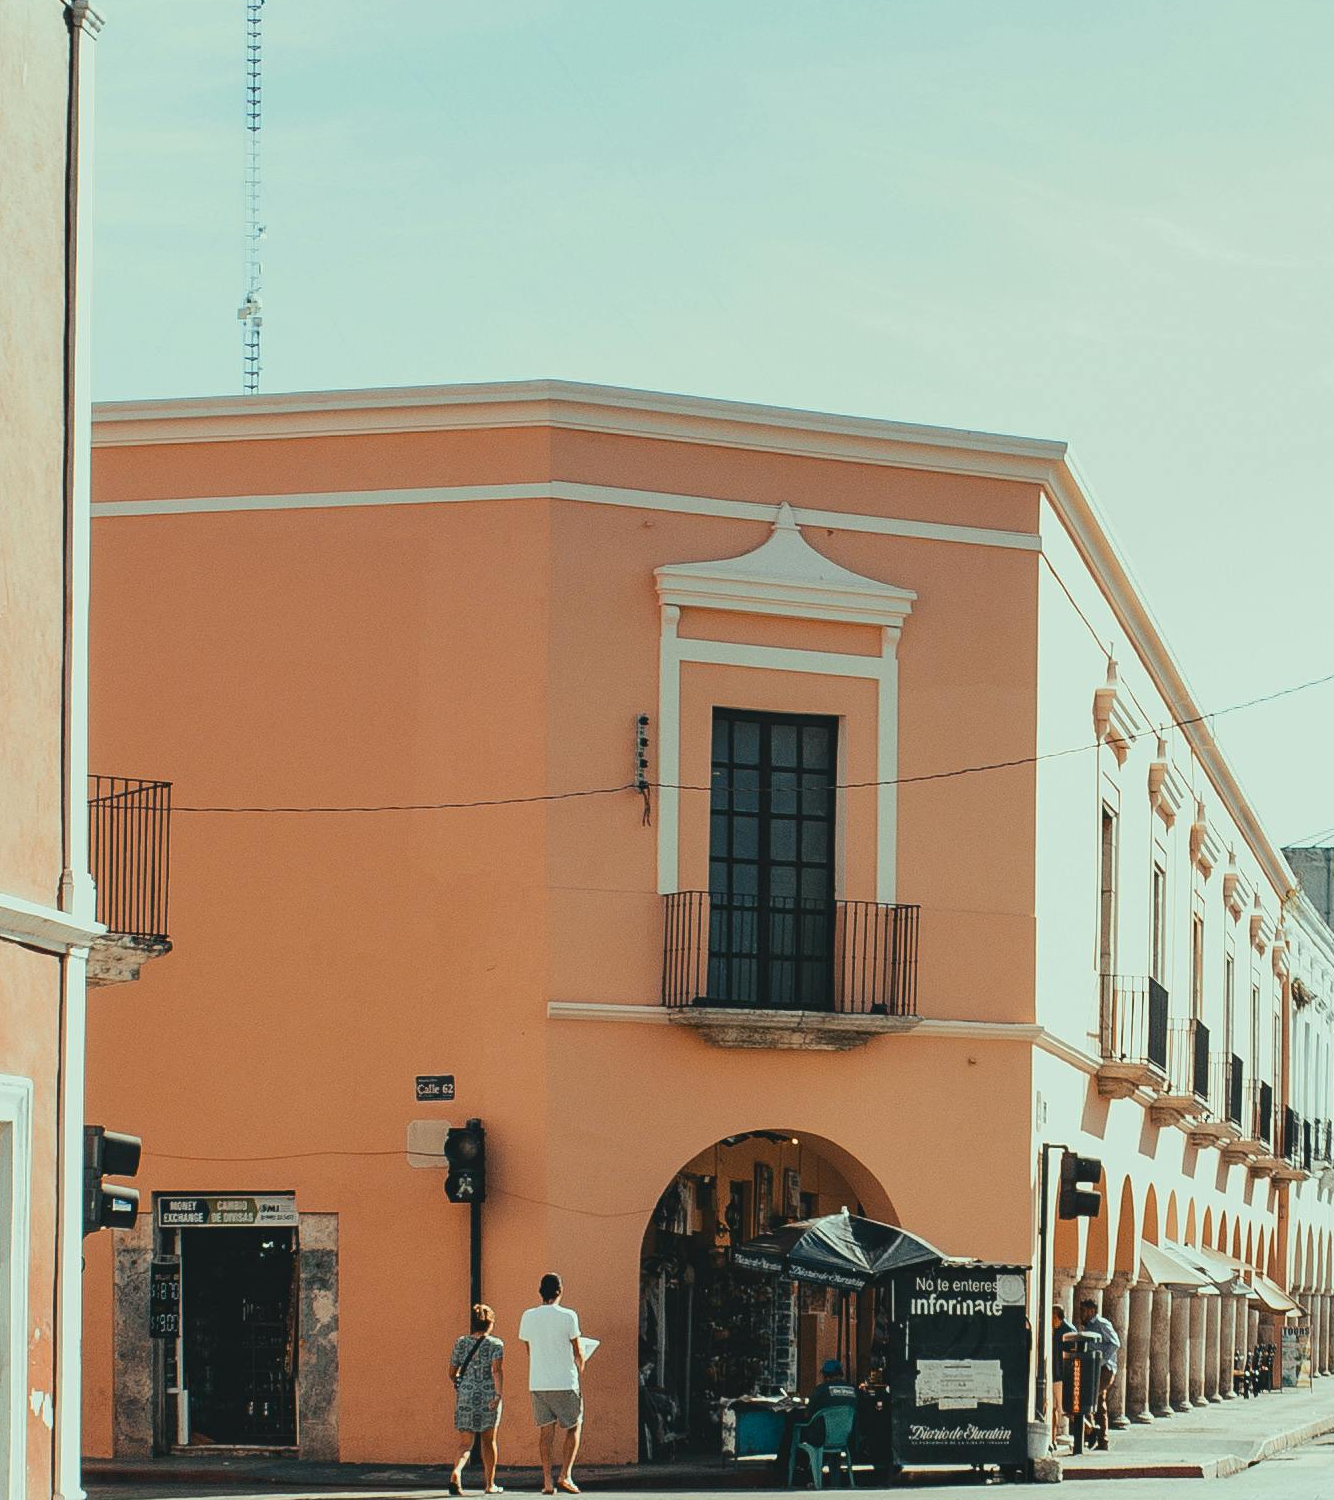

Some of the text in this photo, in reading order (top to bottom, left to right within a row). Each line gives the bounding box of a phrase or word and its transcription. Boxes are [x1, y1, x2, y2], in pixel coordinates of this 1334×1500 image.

[418, 1084, 453, 1094] Calle 62
[170, 1201, 197, 1210] MONEY
[217, 1201, 247, 1210] CAMBIO
[164, 1213, 203, 1222] EXCHANGE
[211, 1213, 221, 1222] DE
[223, 1213, 253, 1222] DIVISAS
[916, 1277, 934, 1292] No
[936, 1278, 949, 1292] te
[952, 1279, 998, 1293] enteres
[1283, 1327, 1309, 1336] TOURS
[908, 1423, 1012, 1440] Diario de Yucatán
